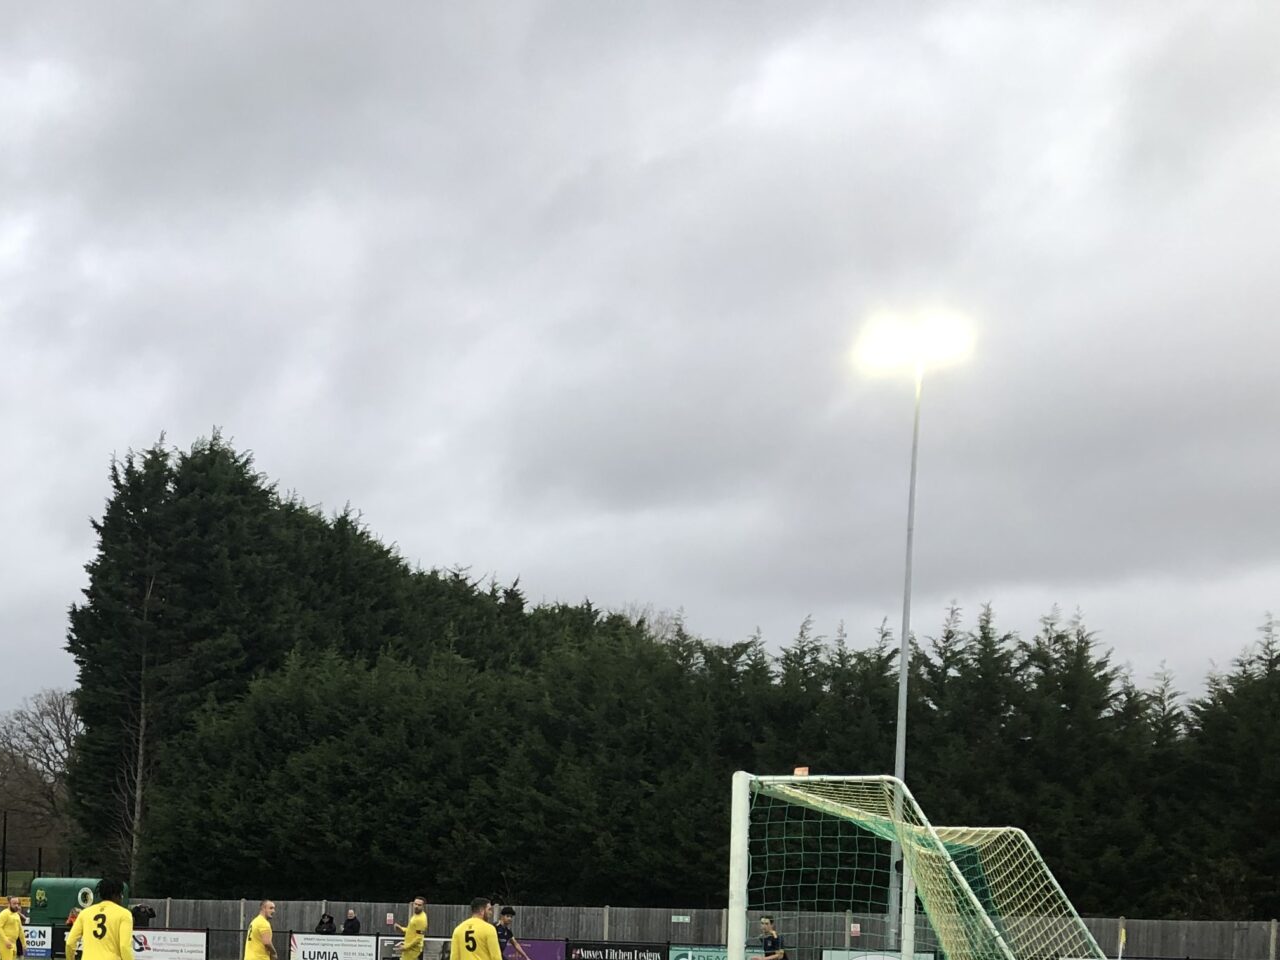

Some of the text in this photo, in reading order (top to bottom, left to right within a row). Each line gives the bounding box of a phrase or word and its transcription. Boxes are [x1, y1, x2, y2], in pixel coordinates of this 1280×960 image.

[93, 914, 107, 940] 3
[465, 930, 477, 952] 5
[302, 951, 339, 960] LUMIA
[580, 948, 603, 960] Sussex
[605, 948, 632, 960] Kitchen
